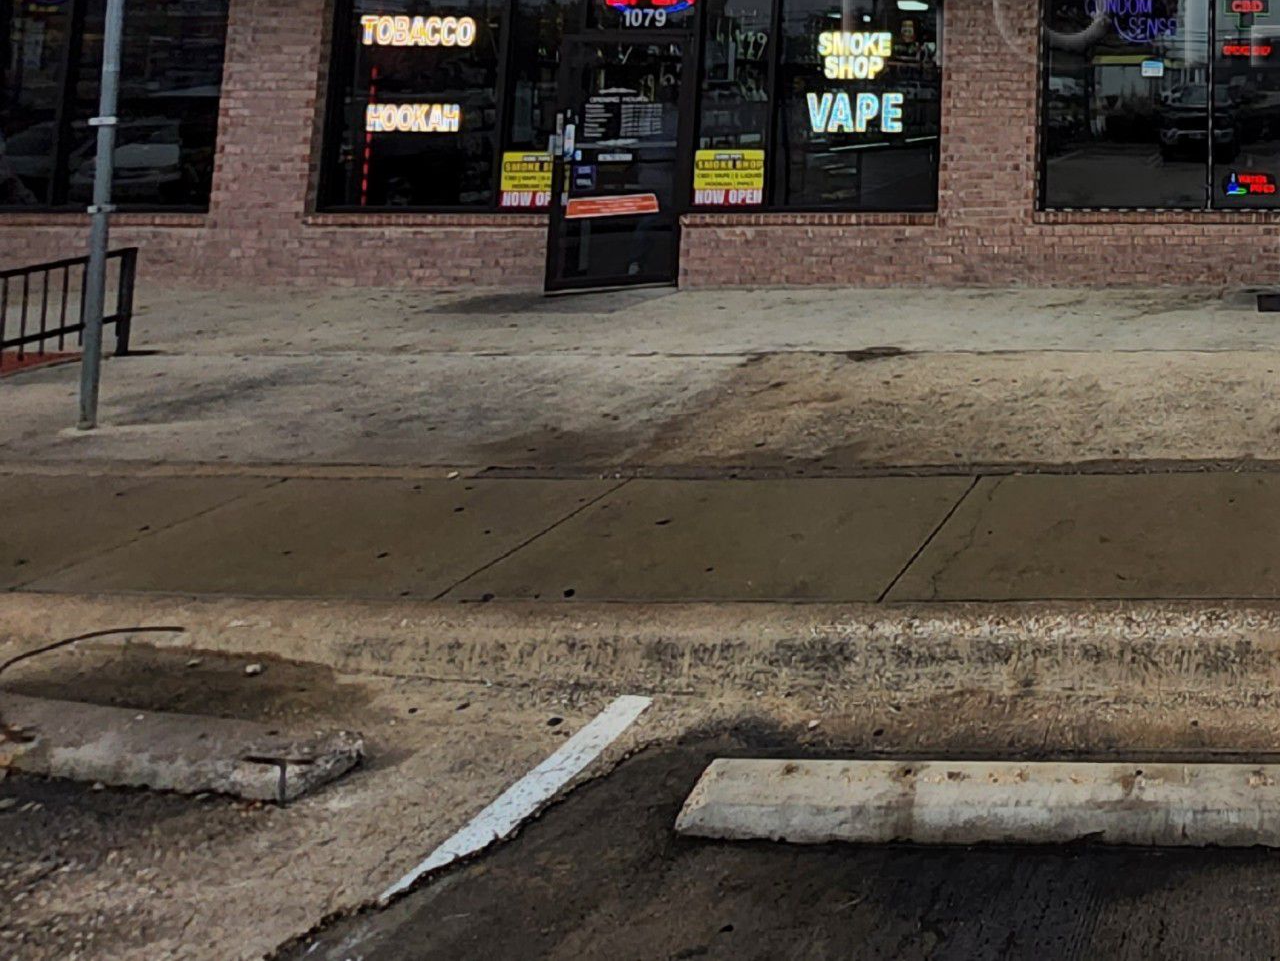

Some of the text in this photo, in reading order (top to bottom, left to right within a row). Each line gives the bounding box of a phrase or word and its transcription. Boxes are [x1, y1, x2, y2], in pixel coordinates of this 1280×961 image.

[624, 9, 667, 27] 1079
[1231, 0, 1264, 13] CBD
[360, 15, 477, 47] TOBACCO
[1128, 16, 1178, 38] SENSE
[817, 31, 892, 56] SMOKE
[823, 56, 884, 80] SHOP
[366, 103, 461, 132] HOOKAH
[806, 92, 905, 133] VAPE
[502, 191, 534, 206] NOW
[694, 189, 763, 204] NOW OPEN
